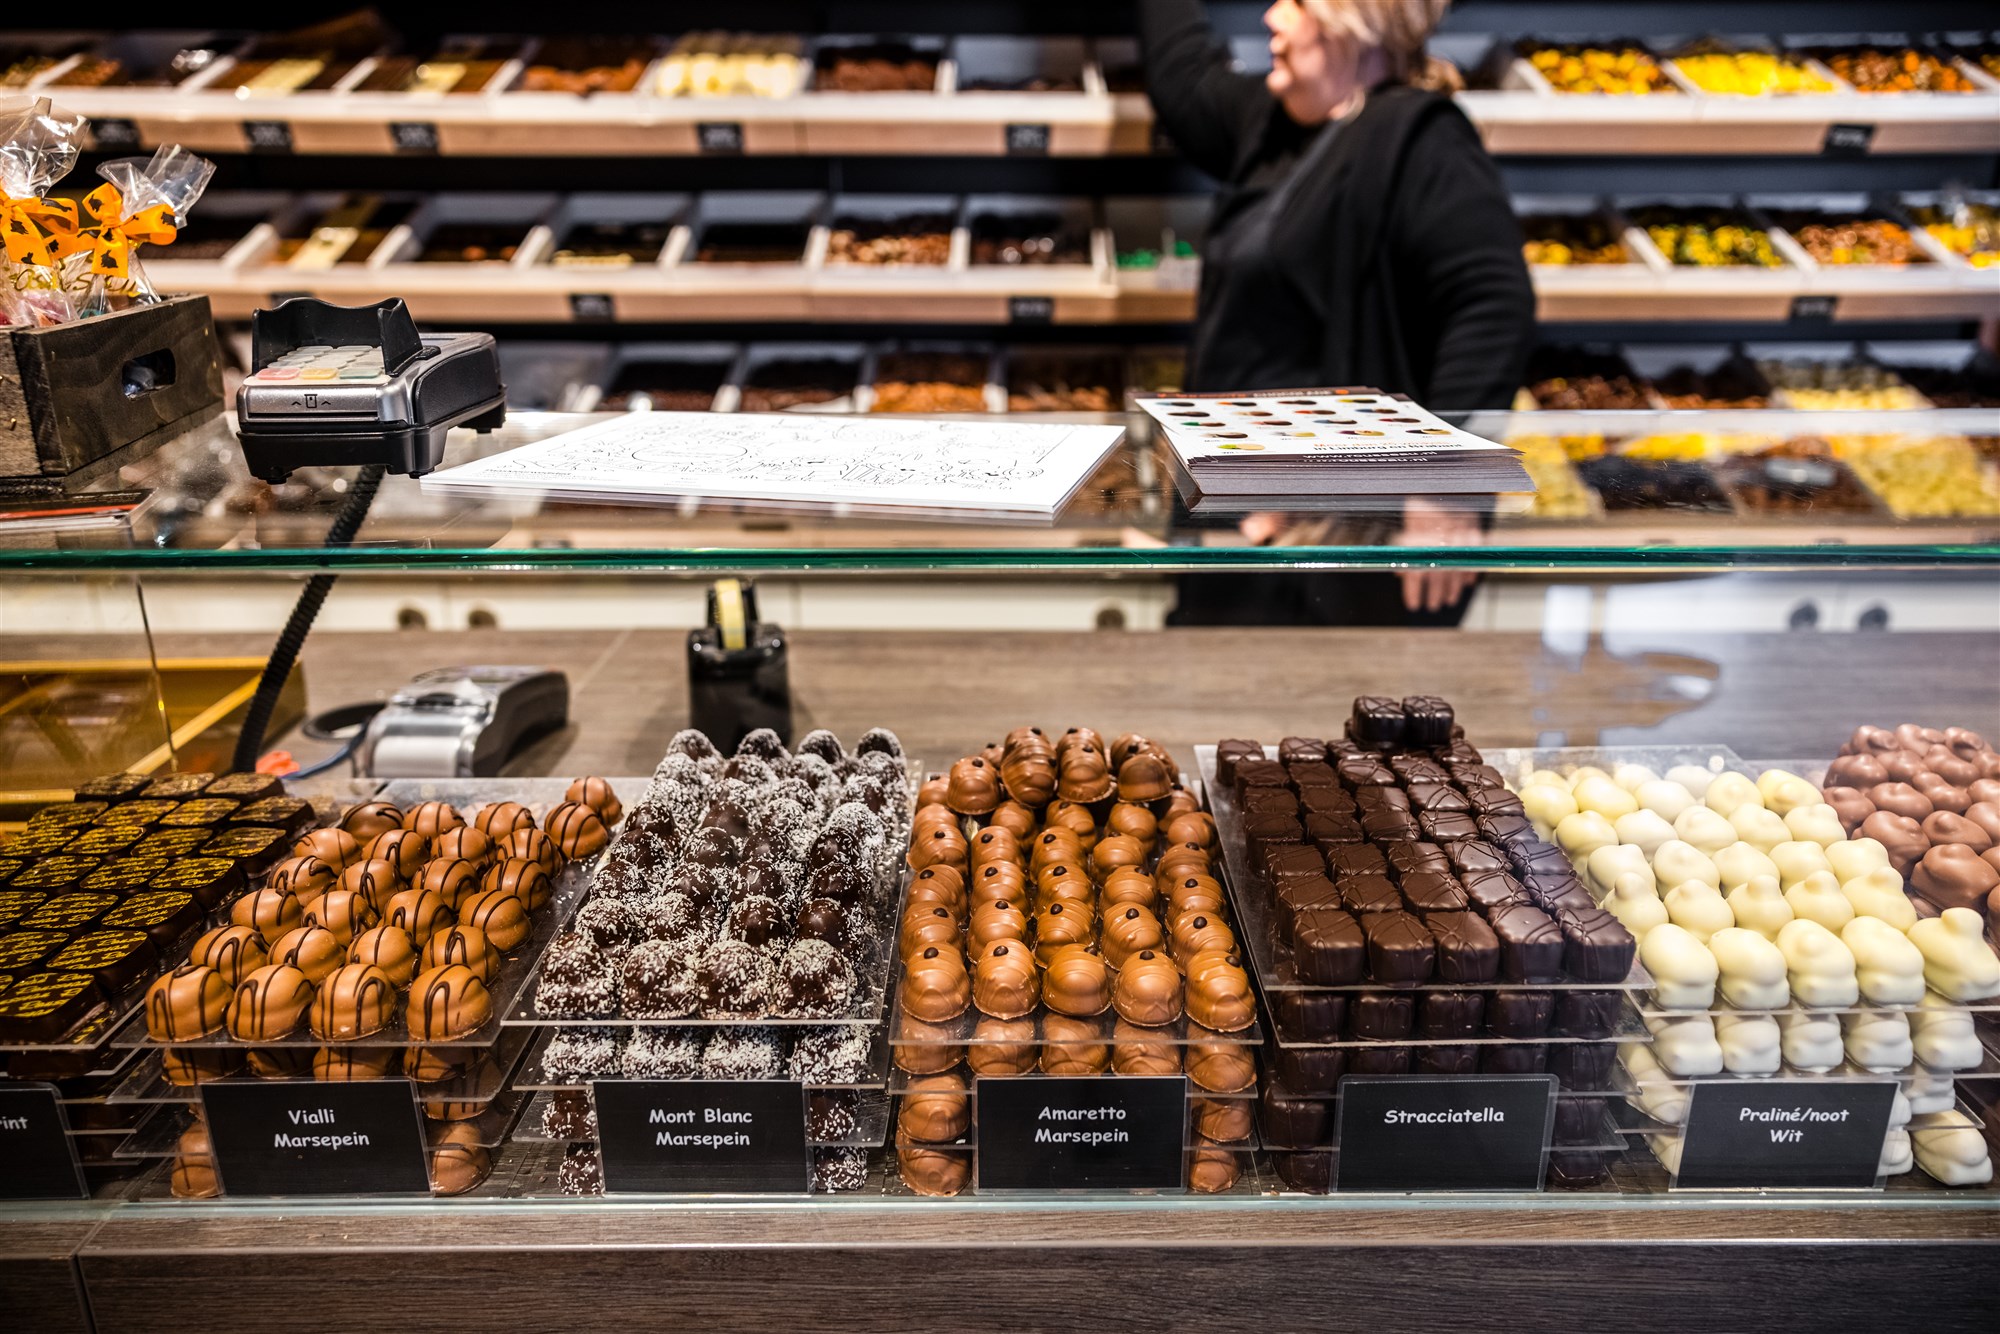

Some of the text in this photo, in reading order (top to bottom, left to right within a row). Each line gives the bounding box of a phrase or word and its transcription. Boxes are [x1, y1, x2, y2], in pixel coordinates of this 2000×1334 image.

[288, 1108, 335, 1125] Vialli
[649, 1107, 753, 1124] Mont Blanc
[1038, 1106, 1127, 1121] Amaretto
[1383, 1106, 1505, 1124] Stracciatella
[1739, 1106, 1850, 1122] Praliné/noot
[274, 1131, 370, 1151] Marsepein
[655, 1131, 751, 1150] Marsepein
[1034, 1127, 1129, 1147] Marsepein
[1770, 1129, 1804, 1143] Wit
